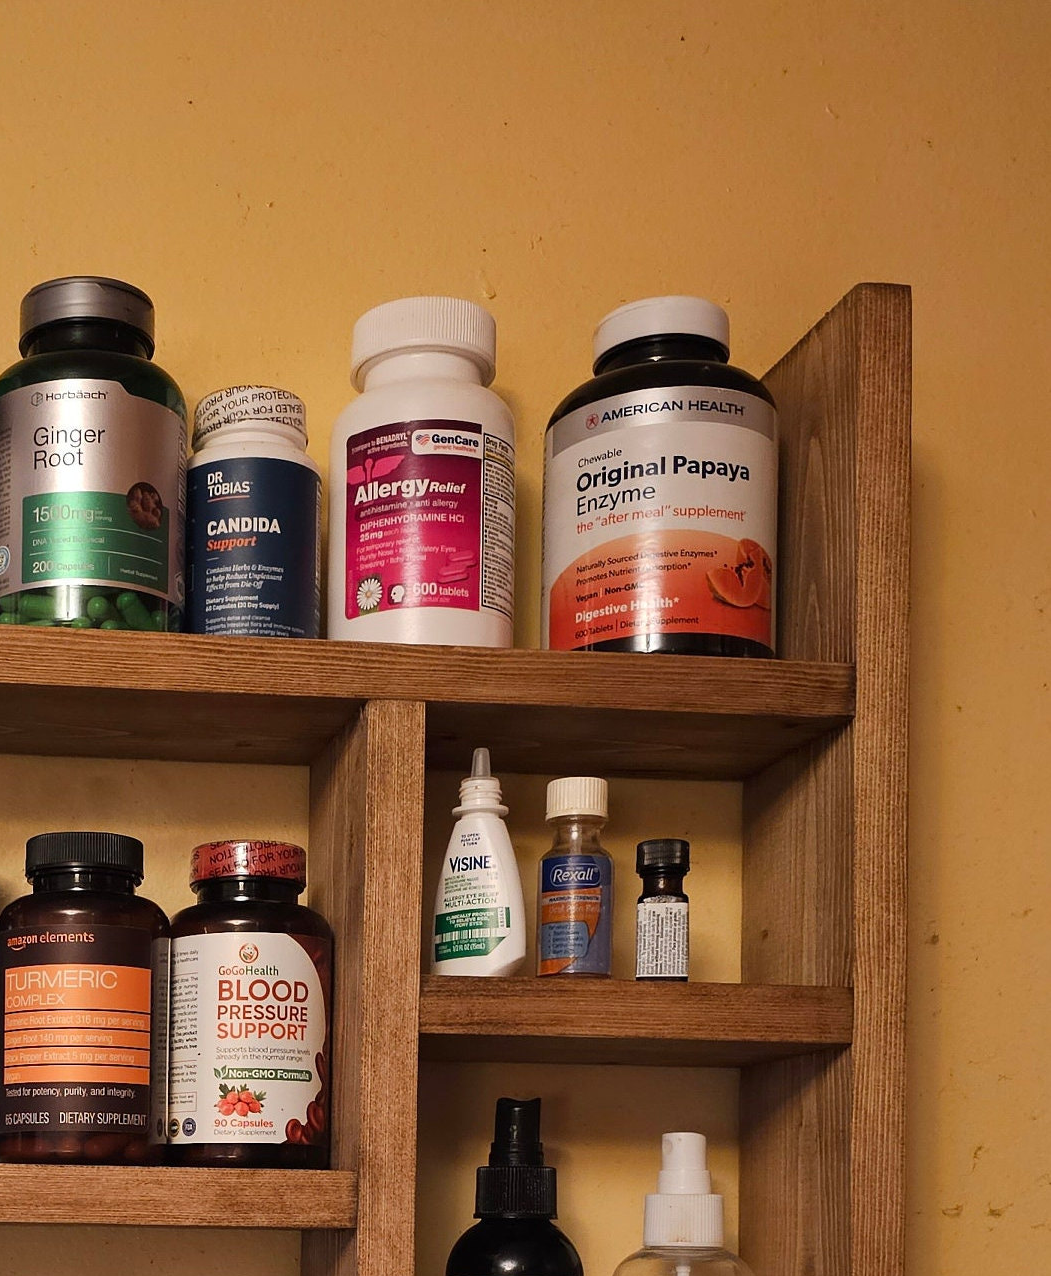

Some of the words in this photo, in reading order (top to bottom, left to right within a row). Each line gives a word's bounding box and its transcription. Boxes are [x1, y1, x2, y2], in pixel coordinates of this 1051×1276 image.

[46, 391, 106, 402] Horbäach
[601, 401, 683, 423] AMERICAN
[689, 400, 744, 416] HEALTH
[34, 426, 105, 447] Ginger
[432, 434, 479, 447] GenCare
[34, 449, 83, 469] Root
[578, 448, 622, 468] Chewable
[208, 472, 222, 484] DR
[577, 457, 665, 492] Original
[673, 455, 750, 482] Papaya
[208, 482, 250, 497] TOBIAS
[354, 478, 430, 505] Allergy
[429, 482, 466, 494] Relief
[577, 486, 655, 516] Enzyme
[208, 517, 281, 536] CANDIDA
[207, 536, 257, 551] Support
[412, 583, 437, 595] 600
[439, 586, 469, 597] tablets
[450, 855, 492, 873] VISINE
[553, 868, 593, 882] Rexall
[445, 898, 497, 909] MULTI-ACTION
[8, 936, 37, 947] amazon
[40, 932, 94, 943] elements
[219, 965, 279, 976] GoGoHealth
[7, 970, 118, 990] TURMERIC
[218, 979, 309, 1003] BLOOD
[6, 994, 65, 1008] COMPLEX
[217, 1005, 308, 1022] PRESSURE
[217, 1023, 307, 1041] SUPPORT
[214, 1119, 228, 1128] 90
[230, 1119, 273, 1128] Capsules
